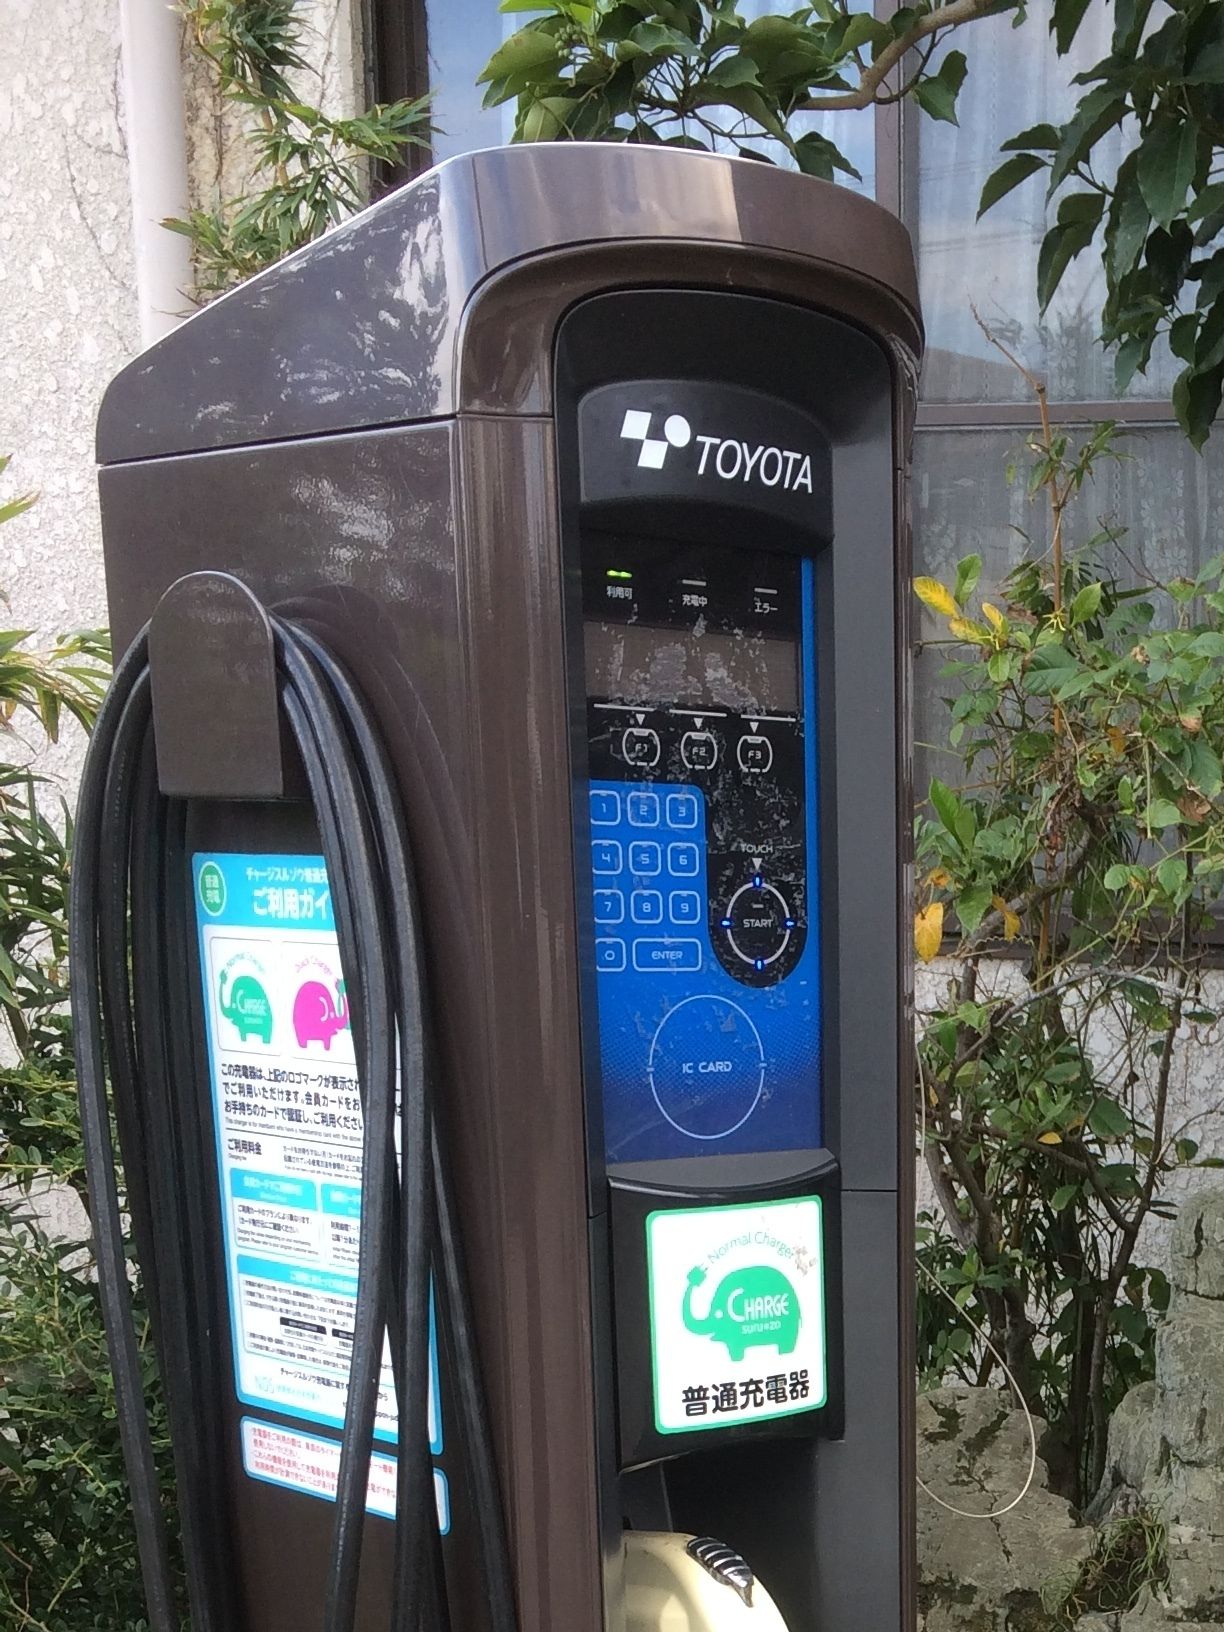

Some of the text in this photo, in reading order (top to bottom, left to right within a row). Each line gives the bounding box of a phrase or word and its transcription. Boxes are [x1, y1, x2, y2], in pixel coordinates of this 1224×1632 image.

[696, 435, 813, 494] TOYOTA
[606, 585, 633, 600] 利用可
[682, 594, 708, 608] 充電中
[754, 602, 779, 614] エラー
[692, 746, 706, 756] F2
[747, 750, 762, 760] F3
[740, 843, 773, 854] TOUCH
[640, 854, 650, 864] 5
[679, 855, 688, 866] 6
[253, 886, 335, 921] ご利用ガイ
[604, 902, 612, 912] 7
[642, 902, 651, 913] 8
[680, 902, 689, 913] 9
[743, 918, 773, 929] START
[651, 950, 683, 961] ENTER
[682, 1060, 733, 1074] IC CARD
[708, 1231, 794, 1264] Normal Charger
[727, 1287, 789, 1323] CHARGE
[682, 1369, 810, 1417] 普通充電器
